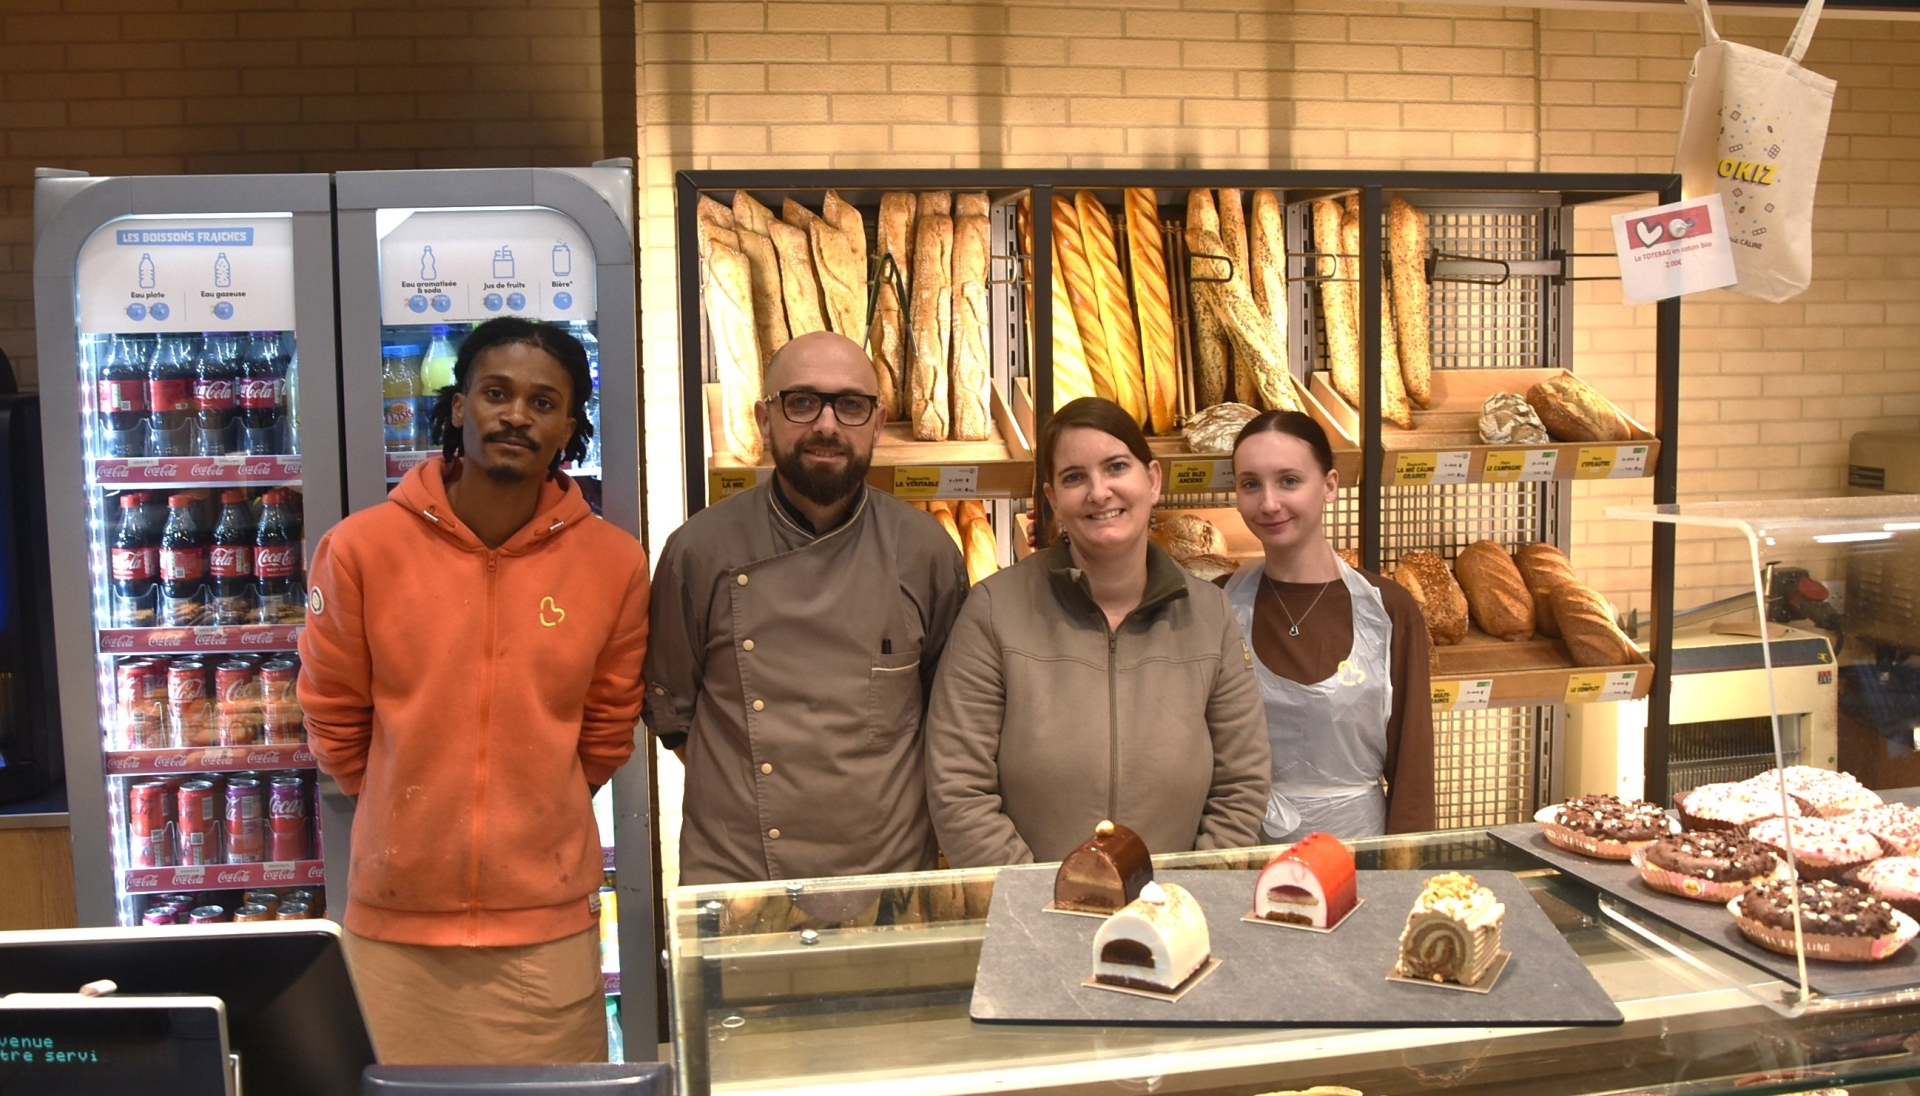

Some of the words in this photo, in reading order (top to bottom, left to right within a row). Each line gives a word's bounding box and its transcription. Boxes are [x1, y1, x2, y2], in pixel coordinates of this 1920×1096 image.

[122, 232, 140, 243] LES
[142, 230, 194, 243] BOISSONS
[1634, 254, 1642, 262] Le
[1643, 248, 1671, 261] TOTEBAG
[1681, 244, 1700, 254] coton
[1701, 240, 1712, 249] bio
[416, 280, 457, 288] aromatisée
[483, 282, 495, 291] Jus
[496, 281, 505, 289] de
[506, 281, 526, 289] fruits
[131, 291, 145, 299] Eau
[146, 290, 165, 300] plate
[201, 290, 215, 298] Eau
[216, 290, 246, 299] gazeuse
[424, 286, 442, 294] soda
[385, 408, 414, 426] Oasis
[45, 1050, 98, 1062] servi
